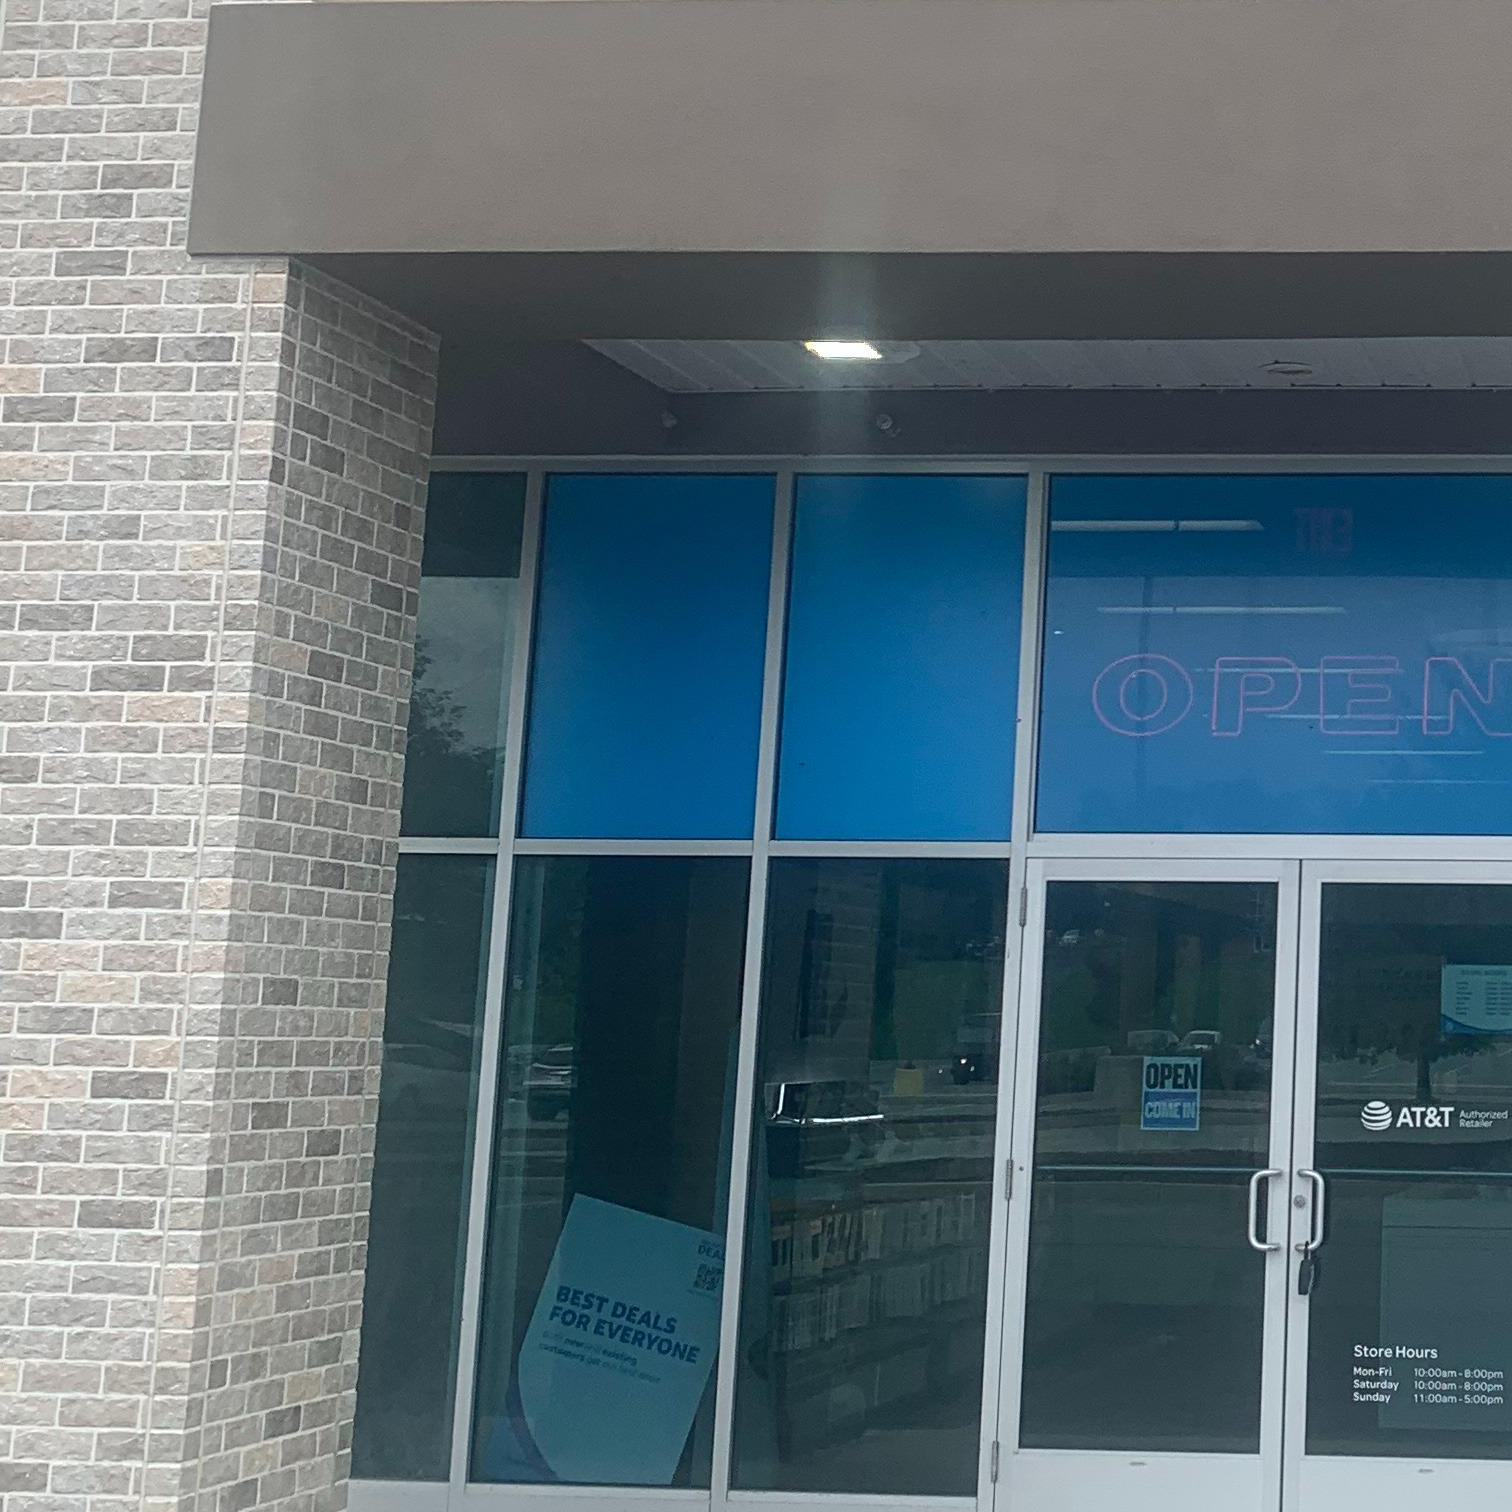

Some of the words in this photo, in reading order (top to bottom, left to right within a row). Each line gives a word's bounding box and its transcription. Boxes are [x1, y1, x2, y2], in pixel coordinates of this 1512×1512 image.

[1145, 1062, 1198, 1090] OPEN
[1144, 1101, 1182, 1119] COME
[1182, 1101, 1197, 1119] IN
[1395, 1105, 1456, 1129] AT&T
[1459, 1109, 1509, 1120] Authorized
[1459, 1119, 1495, 1128] Retailer
[556, 1285, 610, 1314] BEST
[611, 1300, 678, 1334] DEALS
[548, 1305, 592, 1332] FOR
[593, 1318, 701, 1365] EVERYONE
[1353, 1344, 1394, 1359] Store
[1395, 1345, 1439, 1359] Hours
[1352, 1366, 1393, 1377] Mon-Fri
[1352, 1379, 1400, 1391] Saturday
[1352, 1391, 1391, 1404] Sunday
